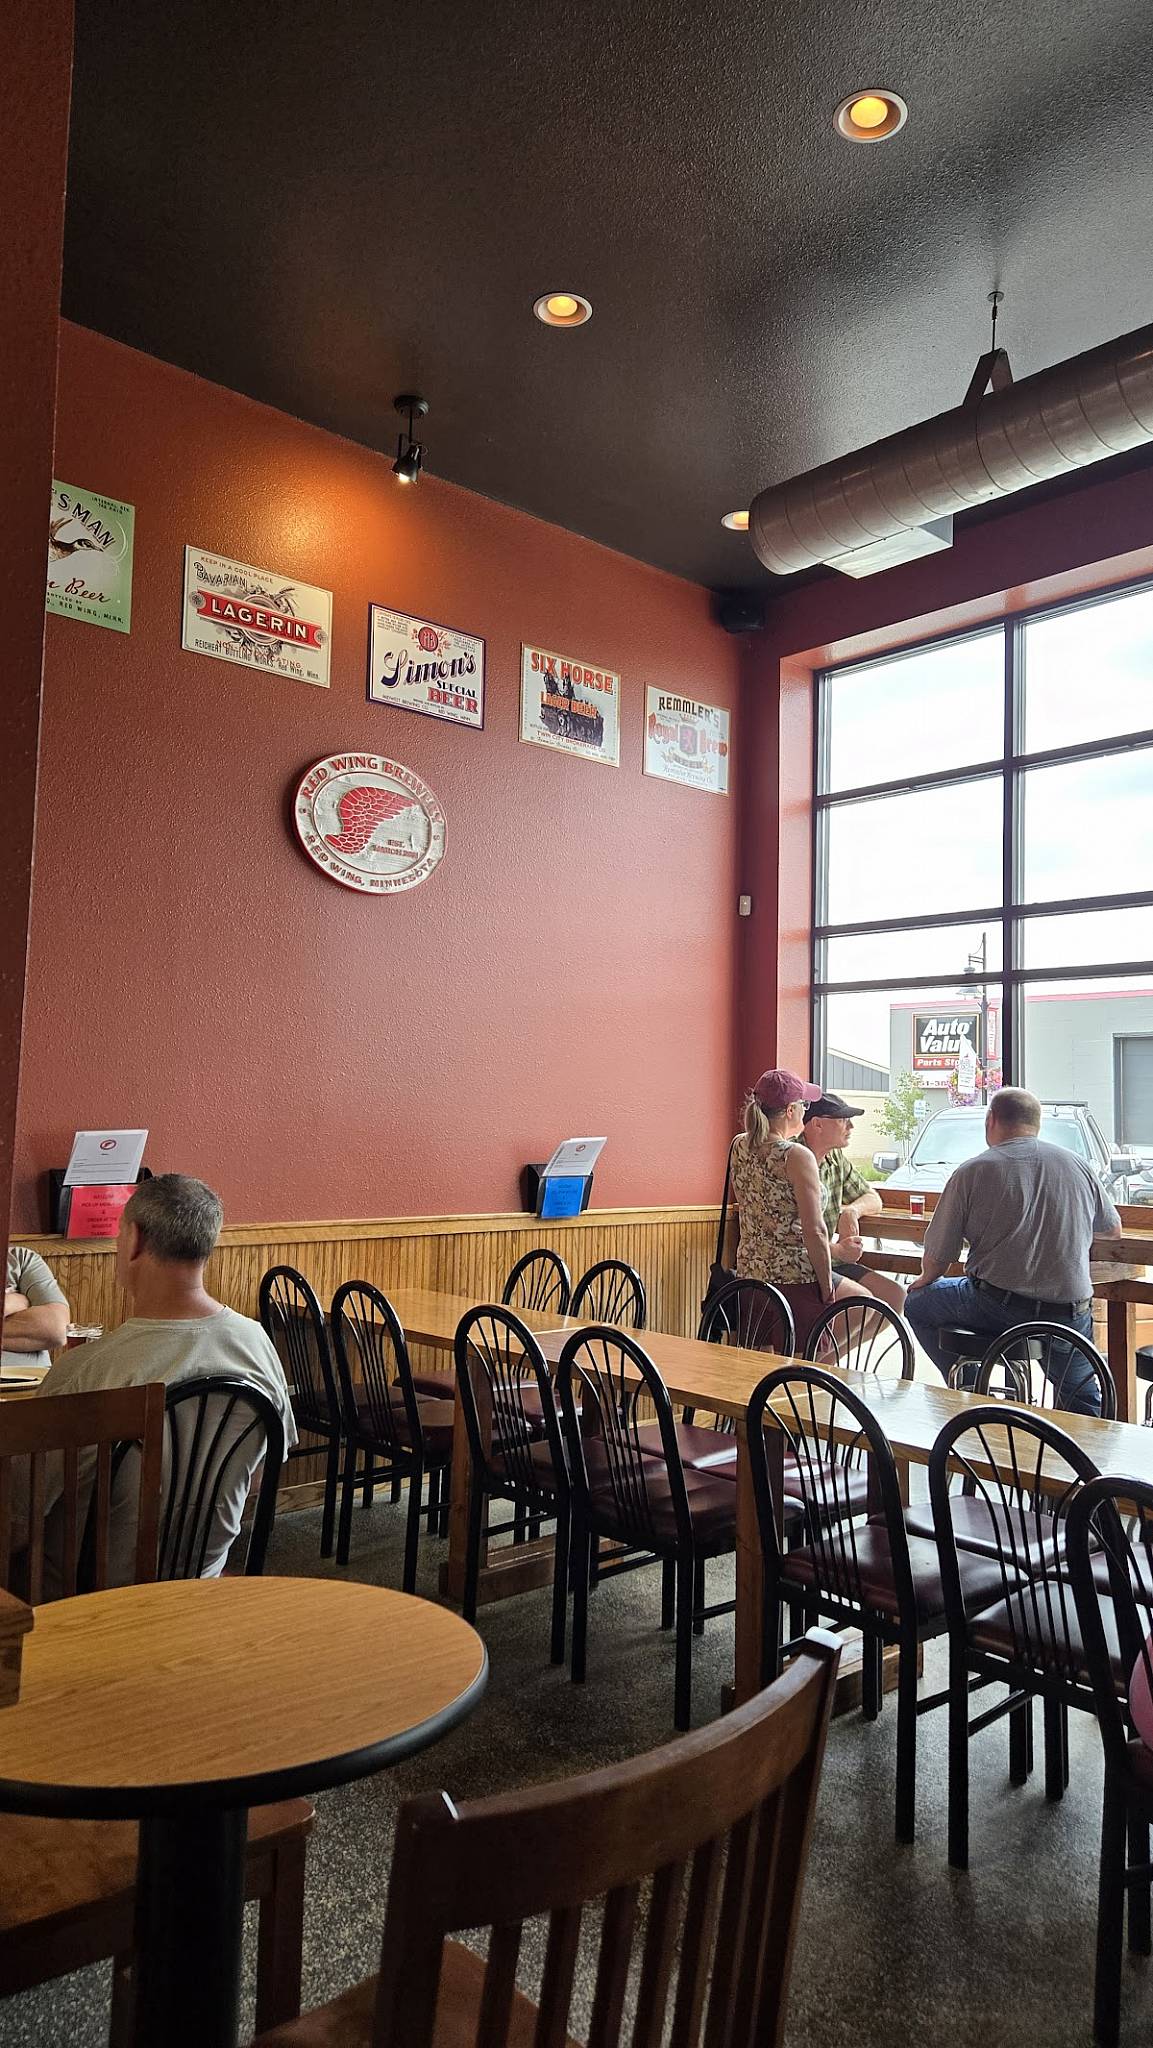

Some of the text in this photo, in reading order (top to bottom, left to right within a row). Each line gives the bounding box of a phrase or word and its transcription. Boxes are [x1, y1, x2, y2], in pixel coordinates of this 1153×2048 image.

[200, 556, 218, 565] KEEP
[234, 566, 251, 578] COOL
[253, 571, 274, 584] PLACE
[65, 578, 110, 603] Beer
[59, 601, 73, 609] RED
[211, 598, 308, 639] LAGERIN
[381, 649, 477, 688] Simon's
[530, 651, 558, 678] SIX
[560, 661, 614, 696] HORSE
[427, 687, 479, 714] BEER
[436, 680, 477, 698] SPECIAL
[571, 699, 598, 719] BEER
[658, 697, 720, 729] REMMLER'S
[302, 767, 329, 800] RED
[331, 756, 378, 771] WING
[305, 832, 436, 888] RED WING, MINNESOTA
[922, 1018, 970, 1036] Auto
[920, 1036, 972, 1053] Valu
[916, 1058, 960, 1067] Parts Sto
